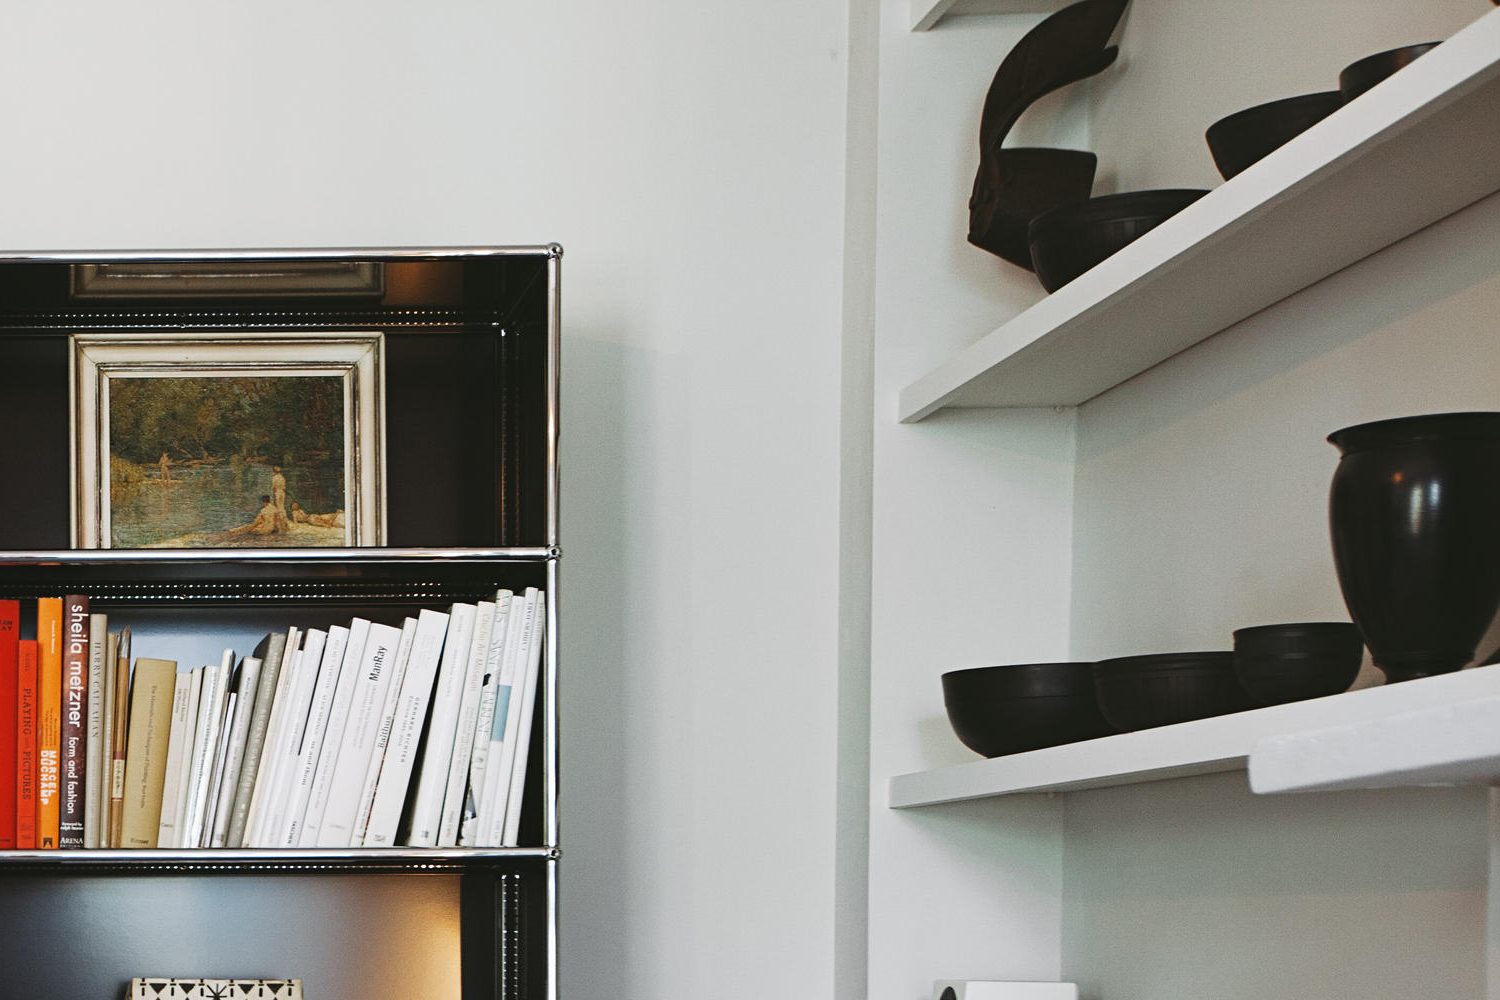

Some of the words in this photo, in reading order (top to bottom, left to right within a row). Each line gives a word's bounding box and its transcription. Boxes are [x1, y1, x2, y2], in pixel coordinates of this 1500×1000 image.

[71, 604, 89, 654] sheila
[92, 641, 101, 677] HARRY
[477, 642, 486, 656] Art
[470, 658, 485, 692] Museum
[23, 688, 31, 735] PLAYING
[69, 661, 84, 728] metzner
[91, 681, 101, 739] CALLAHAN
[407, 697, 421, 732] GERHARD
[68, 736, 80, 757] form
[377, 716, 392, 749] Balthus
[400, 733, 413, 763] RICHTER
[22, 751, 31, 800] PICTURES
[40, 750, 49, 805] DUCHAMP
[49, 750, 57, 794] MARCEL
[67, 760, 78, 778] and
[67, 781, 78, 814] fashion
